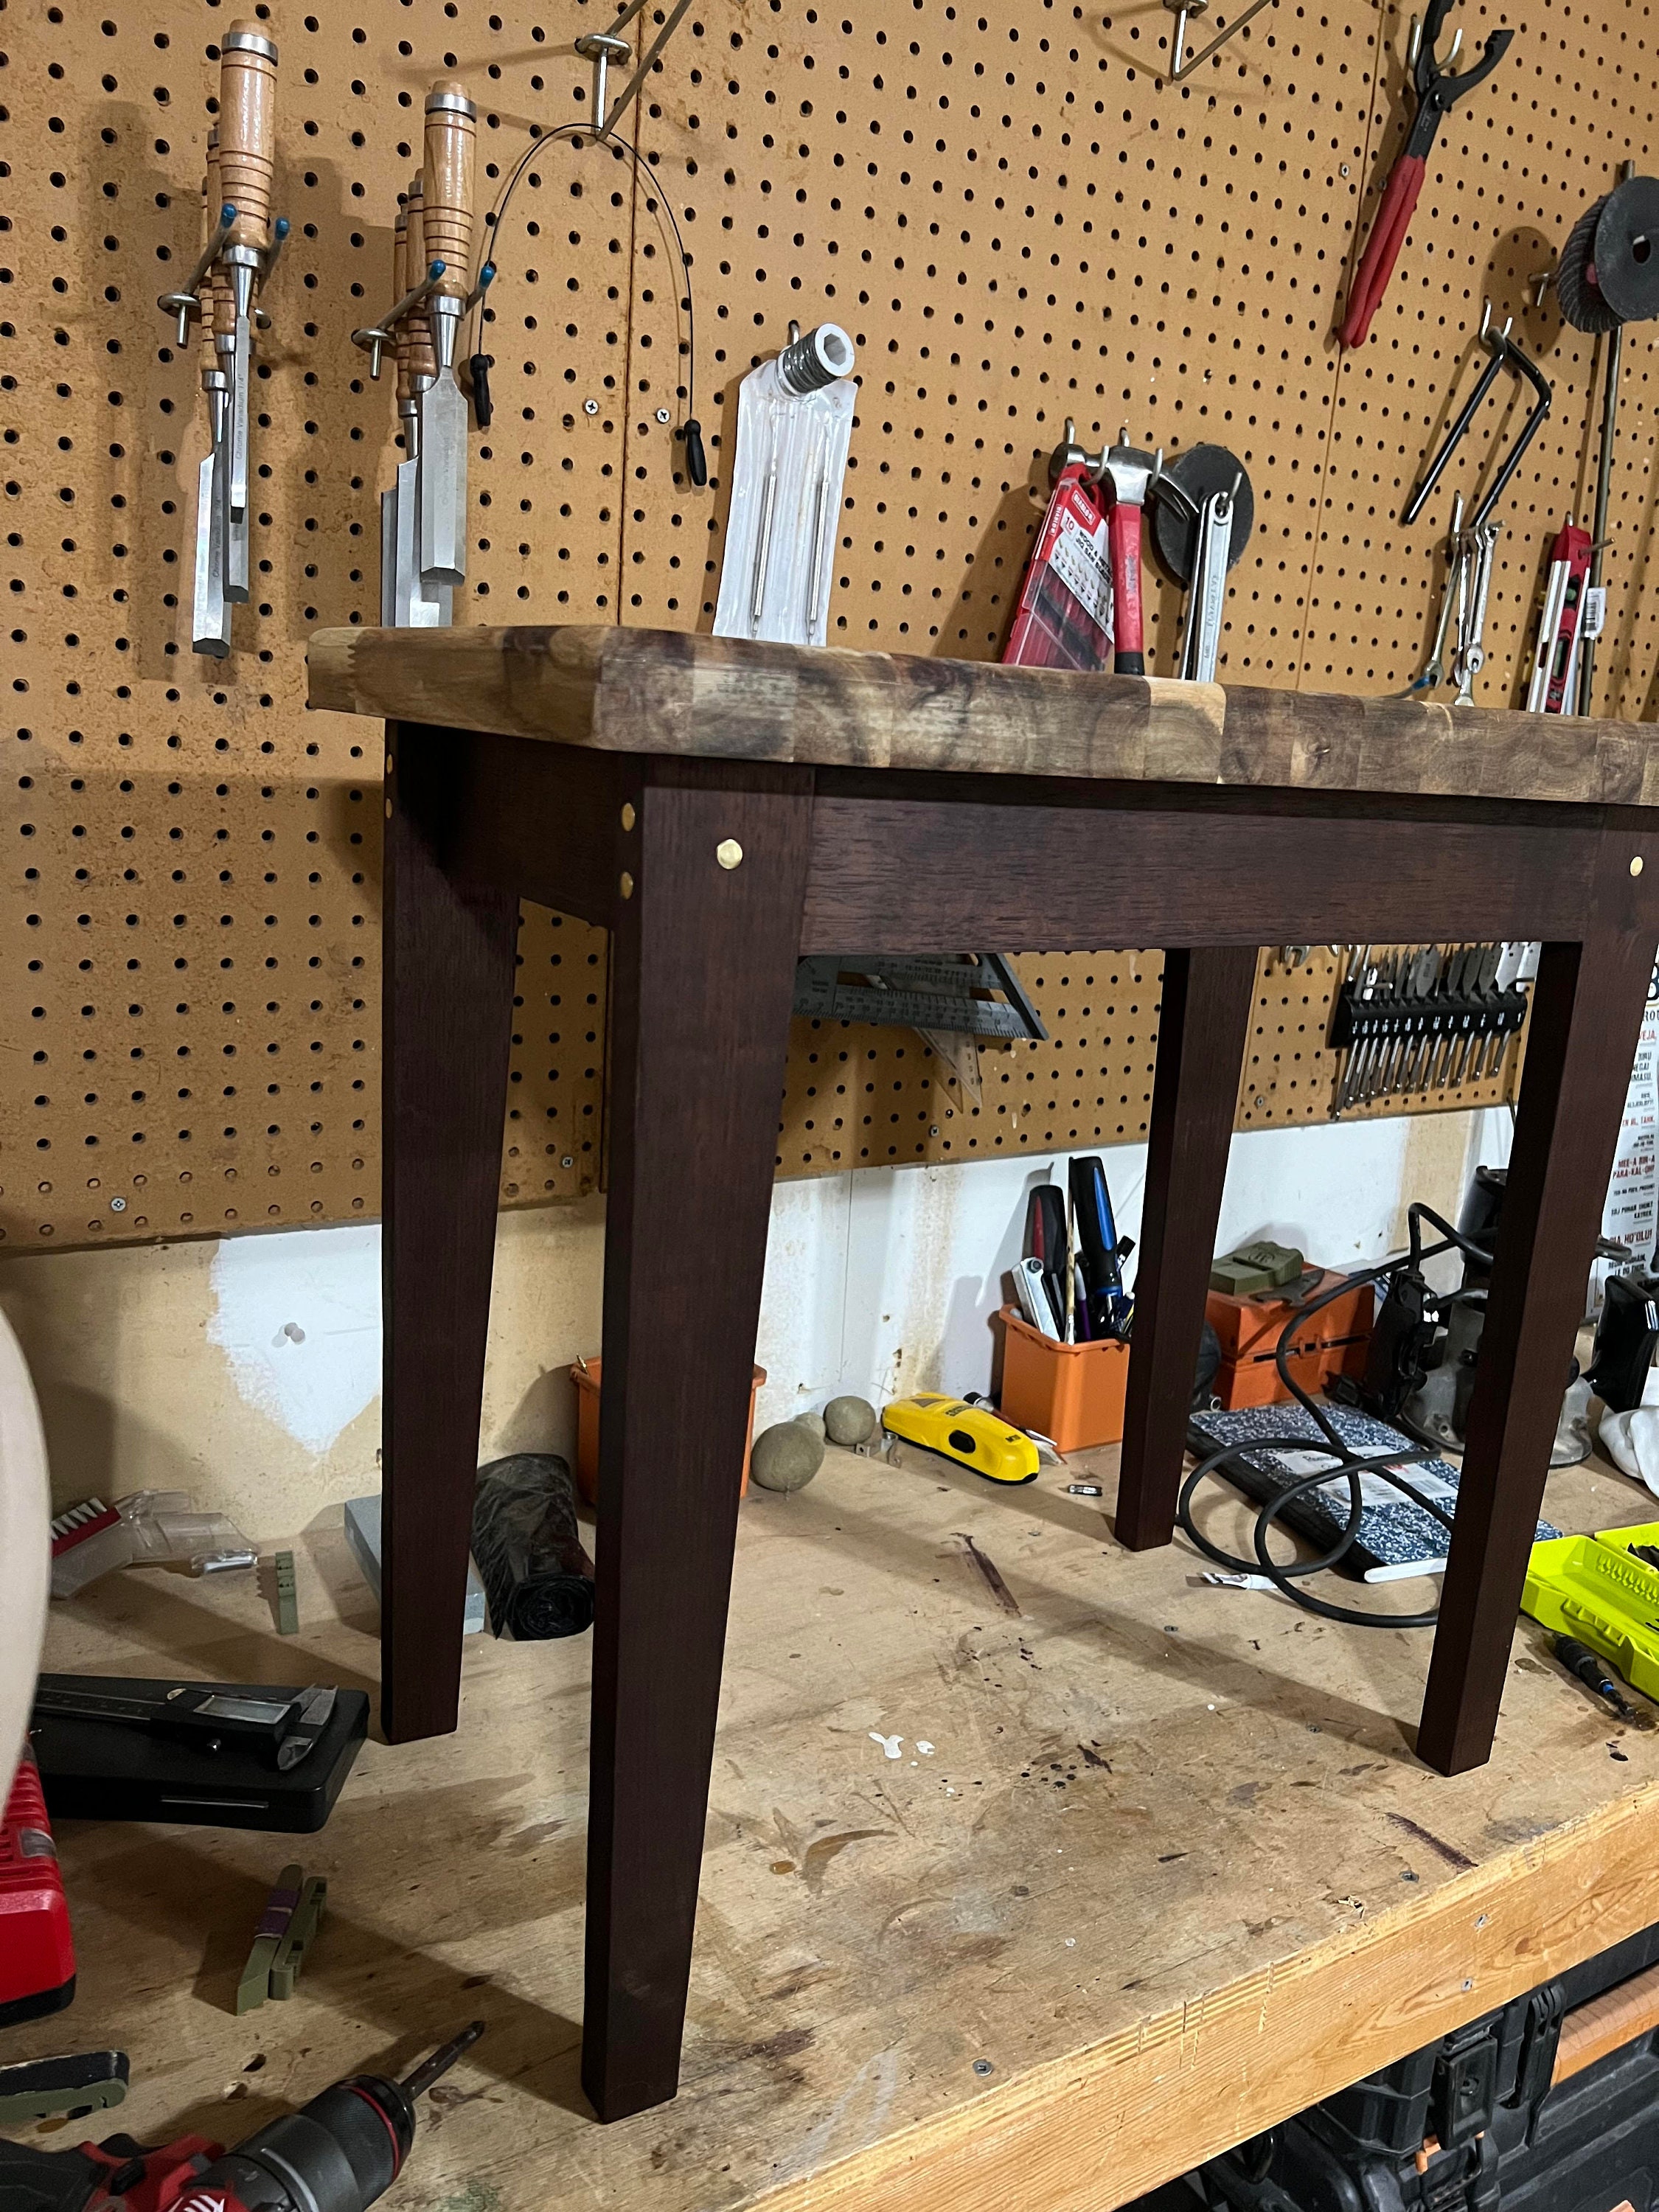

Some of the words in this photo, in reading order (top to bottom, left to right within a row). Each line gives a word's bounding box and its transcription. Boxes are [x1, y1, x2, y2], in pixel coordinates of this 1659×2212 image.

[236, 392, 245, 428] Vanadium
[235, 430, 243, 460] Chrome
[1079, 529, 1094, 552] WOOD
[212, 551, 221, 578] Chrome
[1084, 548, 1096, 563] SAW
